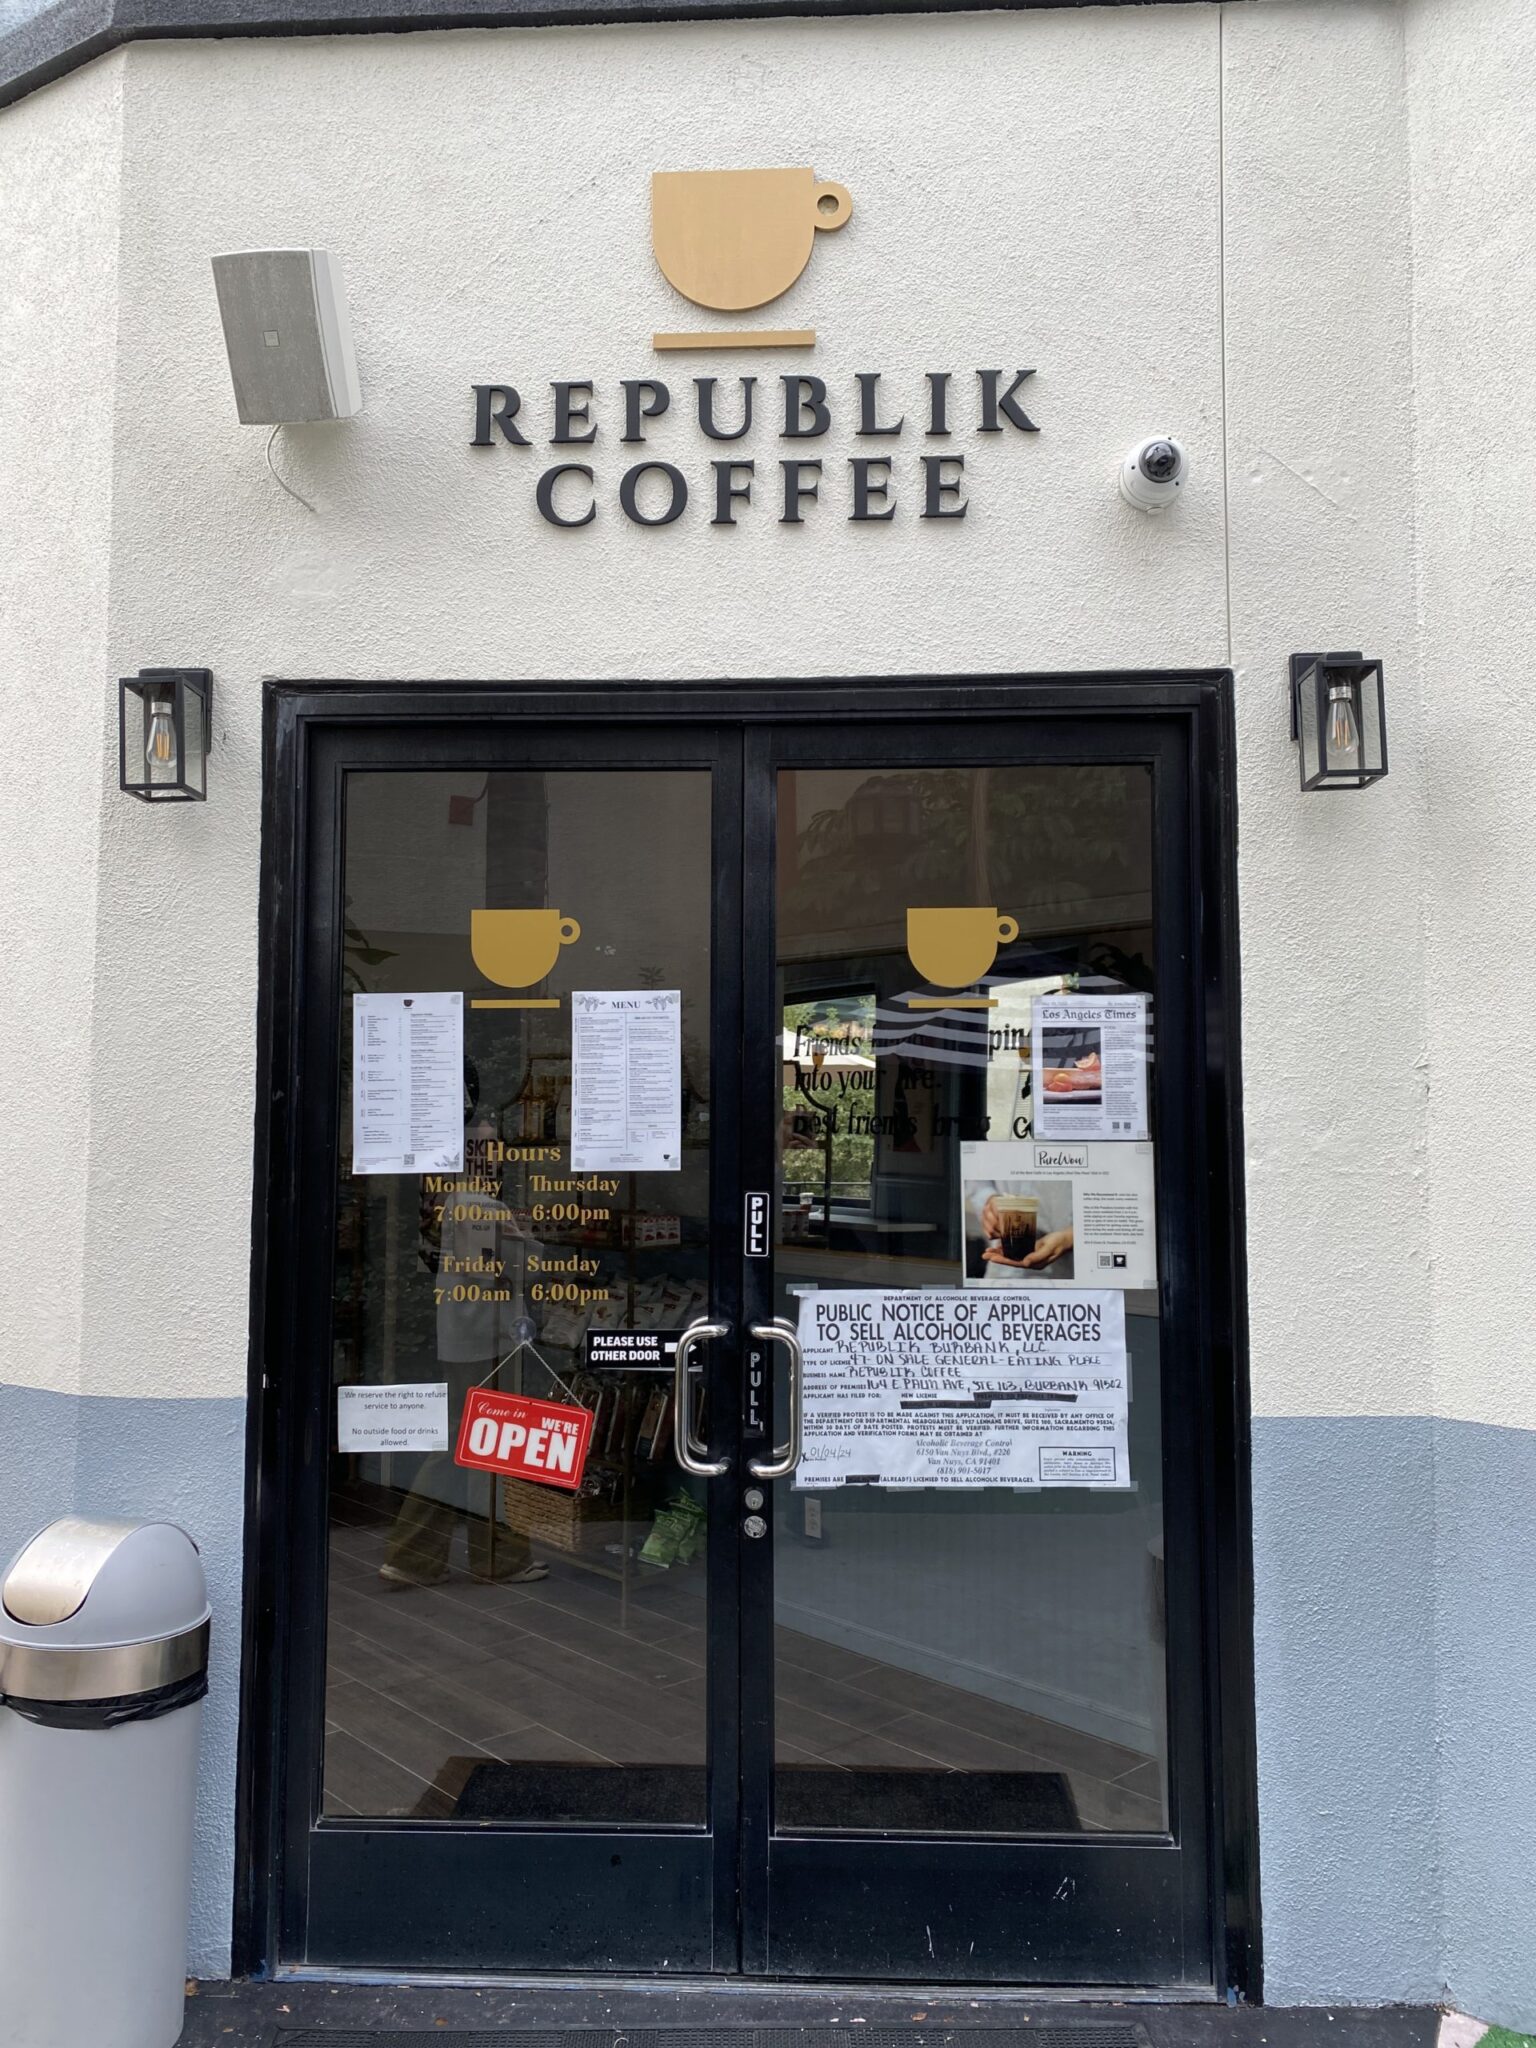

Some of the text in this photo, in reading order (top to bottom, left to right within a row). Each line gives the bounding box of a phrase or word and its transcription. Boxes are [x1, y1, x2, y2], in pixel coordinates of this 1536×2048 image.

[469, 368, 1041, 447] REPUBLIK
[535, 454, 970, 529] COFFEE
[611, 1001, 640, 1009] MENU
[1042, 1009, 1137, 1025] Los Angeles Times
[793, 1024, 862, 1057] Friends
[848, 1101, 917, 1136] friens
[487, 1142, 562, 1162] Hours
[1039, 1153, 1083, 1165] PureWow
[426, 1176, 502, 1197] Monday
[530, 1175, 620, 1196] Thursday
[434, 1205, 512, 1221] 7:00am
[532, 1204, 610, 1225] 6:00pm
[751, 1197, 763, 1252] PULL
[443, 1255, 505, 1277] Friday
[527, 1254, 600, 1276] Sunday
[433, 1285, 510, 1303] 7:00am
[531, 1284, 609, 1305] 6:00pm
[816, 1304, 1101, 1322] PUBLIC NOTICE OF APPLICATION
[817, 1323, 1101, 1341] TO SELL ALCOHOLIC BEVERAGES
[593, 1337, 658, 1347] PLEASE USE
[835, 1340, 920, 1353] REPUBLIK
[591, 1351, 660, 1361] OTHER DOOR
[876, 1355, 894, 1366] ON
[902, 1355, 929, 1366] SALE
[846, 1366, 961, 1377] REPUBLIK COFFEE
[750, 1353, 761, 1425] PULL
[892, 1378, 899, 1390] E
[398, 1391, 413, 1400] right
[399, 1403, 425, 1411] anyone.
[477, 1401, 528, 1419] Come in
[541, 1416, 580, 1436] WE'RE
[468, 1417, 577, 1474] OPEN
